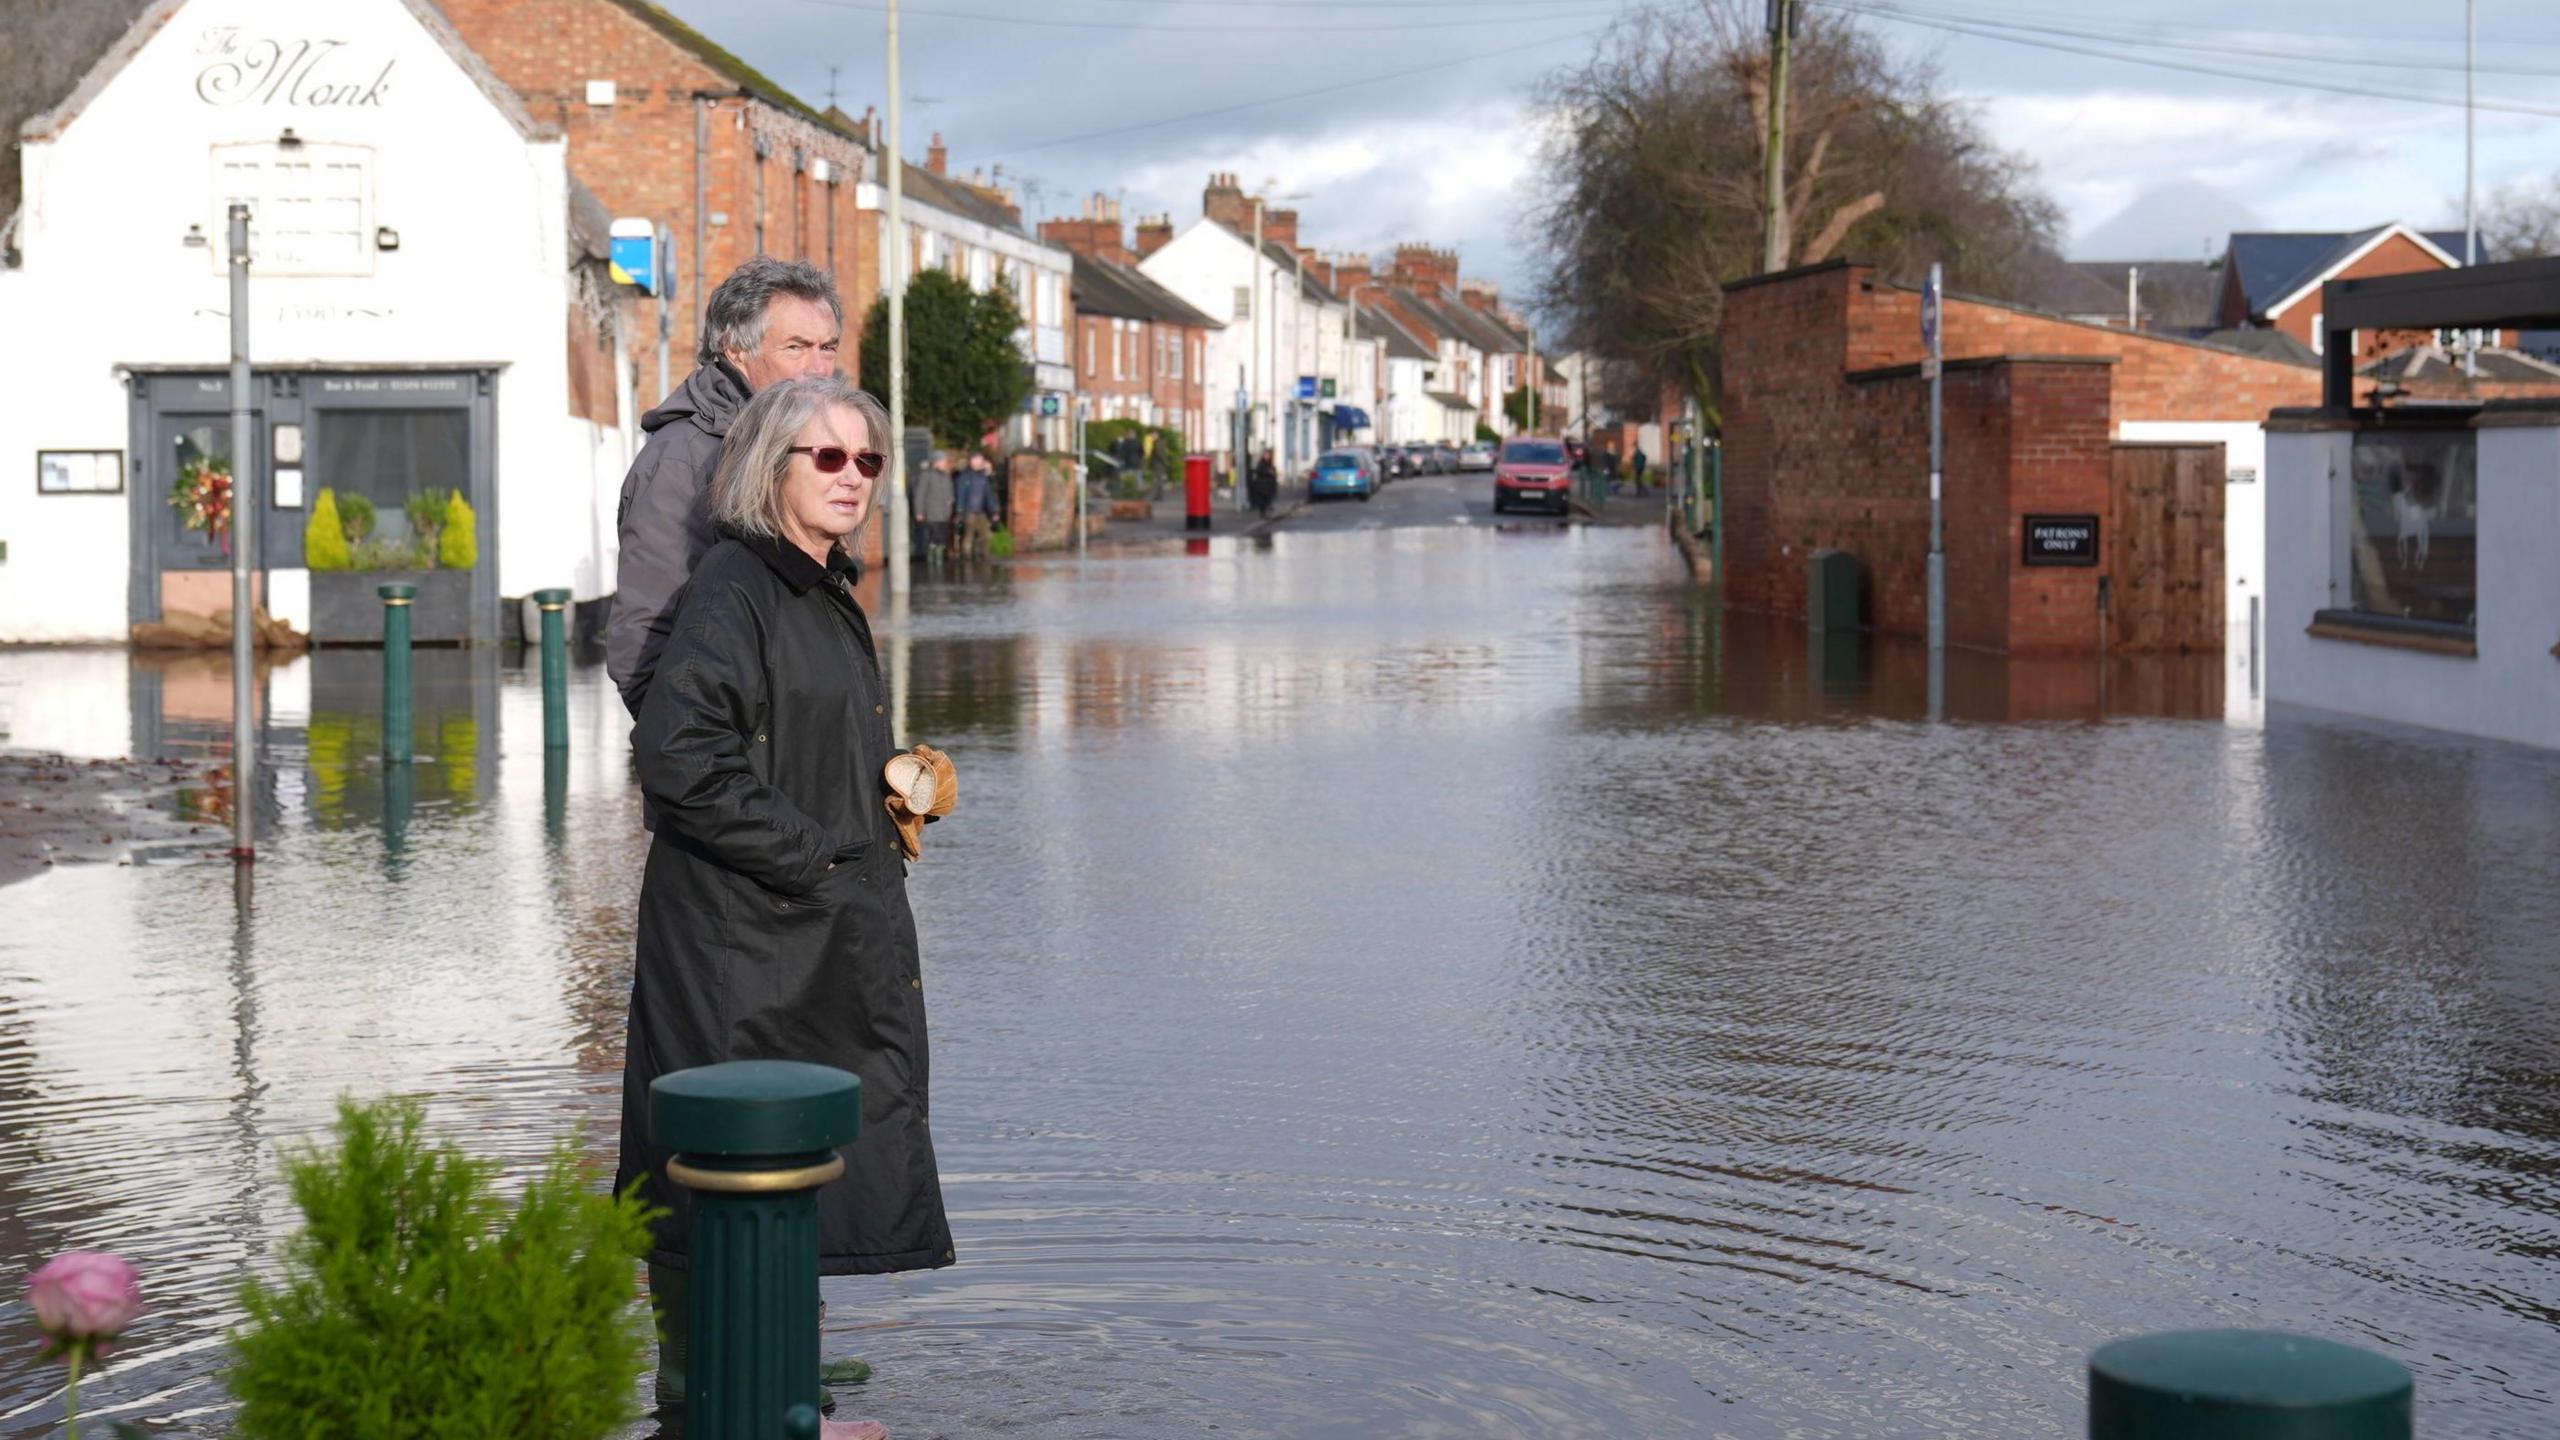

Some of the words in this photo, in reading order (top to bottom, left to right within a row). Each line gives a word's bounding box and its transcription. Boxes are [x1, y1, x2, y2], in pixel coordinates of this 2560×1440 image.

[195, 38, 396, 107] Monk
[2034, 527, 2088, 539] PATRONS
[2043, 540, 2077, 551] ONLY
